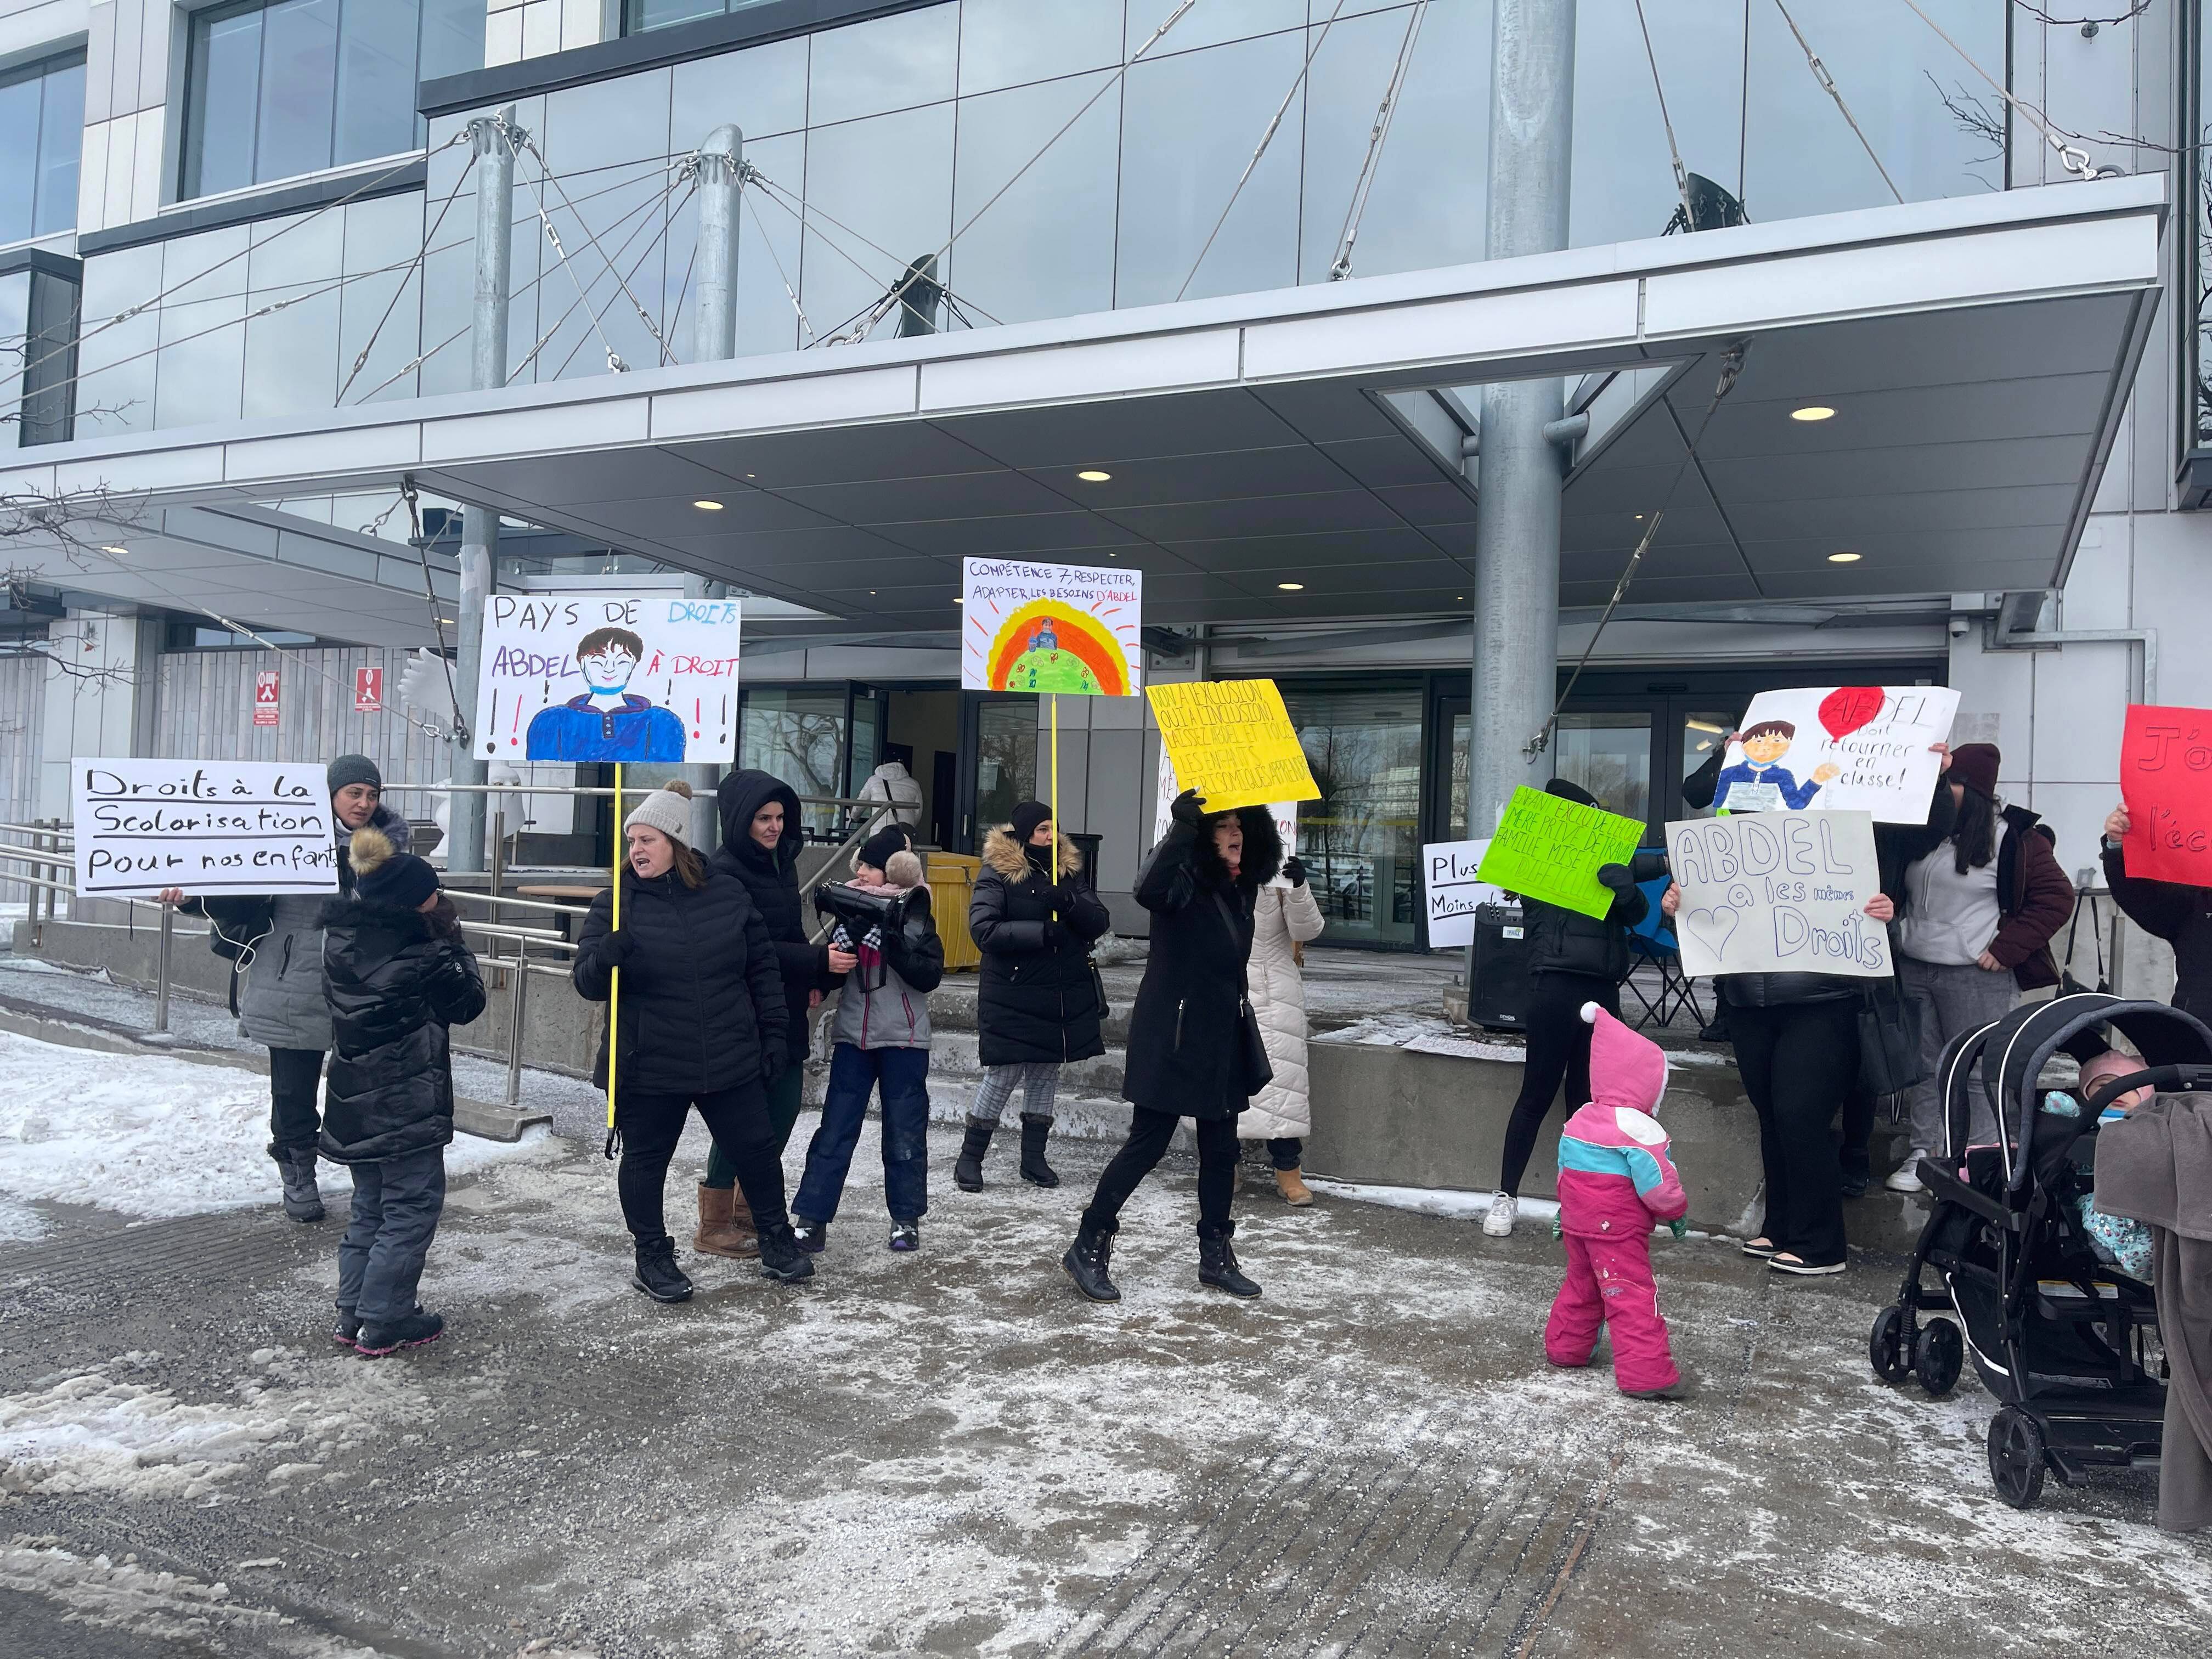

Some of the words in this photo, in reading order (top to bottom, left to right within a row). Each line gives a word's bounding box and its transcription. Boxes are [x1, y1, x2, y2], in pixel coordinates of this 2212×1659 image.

[970, 561, 1052, 579] COMPÉTENCE
[1031, 588, 1046, 597] LES
[1050, 588, 1094, 599] BESOINS
[494, 596, 579, 632] PAYS
[603, 600, 641, 624] DE
[668, 602, 738, 624] DROITS
[492, 645, 580, 678] ABDEL
[671, 656, 740, 677] DROIT
[1149, 685, 1176, 708] NON
[1160, 707, 1188, 728] OUI
[1821, 695, 1933, 728] ABDEL
[1165, 727, 1211, 749] LAISSEZ
[1211, 725, 1244, 746] ABDEL
[1244, 724, 1258, 743] ET
[1262, 719, 1295, 740] TOUS
[1821, 738, 1914, 758] retourner
[1179, 752, 1203, 774] LES
[1206, 746, 1261, 771] ENFANTS
[1856, 757, 1876, 769] en
[87, 769, 217, 799] Droits
[232, 778, 252, 795] à
[1841, 768, 1906, 791] classe!
[94, 805, 322, 832] Scolarisation
[1513, 788, 1559, 812] ENFANT
[1555, 800, 1594, 828] EXCLU
[1593, 809, 1612, 832] DE
[1494, 826, 1543, 857] FAMILLE
[1547, 842, 1585, 869] MISE
[1583, 831, 1605, 854] DE
[1675, 818, 1853, 887] ABDEL
[202, 853, 244, 870] nos
[253, 843, 338, 871] enfants
[1433, 854, 1477, 881] Plus
[1432, 894, 1474, 915] Moins
[1728, 884, 1754, 907] a
[1765, 876, 1806, 904] les
[1813, 885, 1854, 901] mêmes
[1774, 905, 1883, 969] Droits
